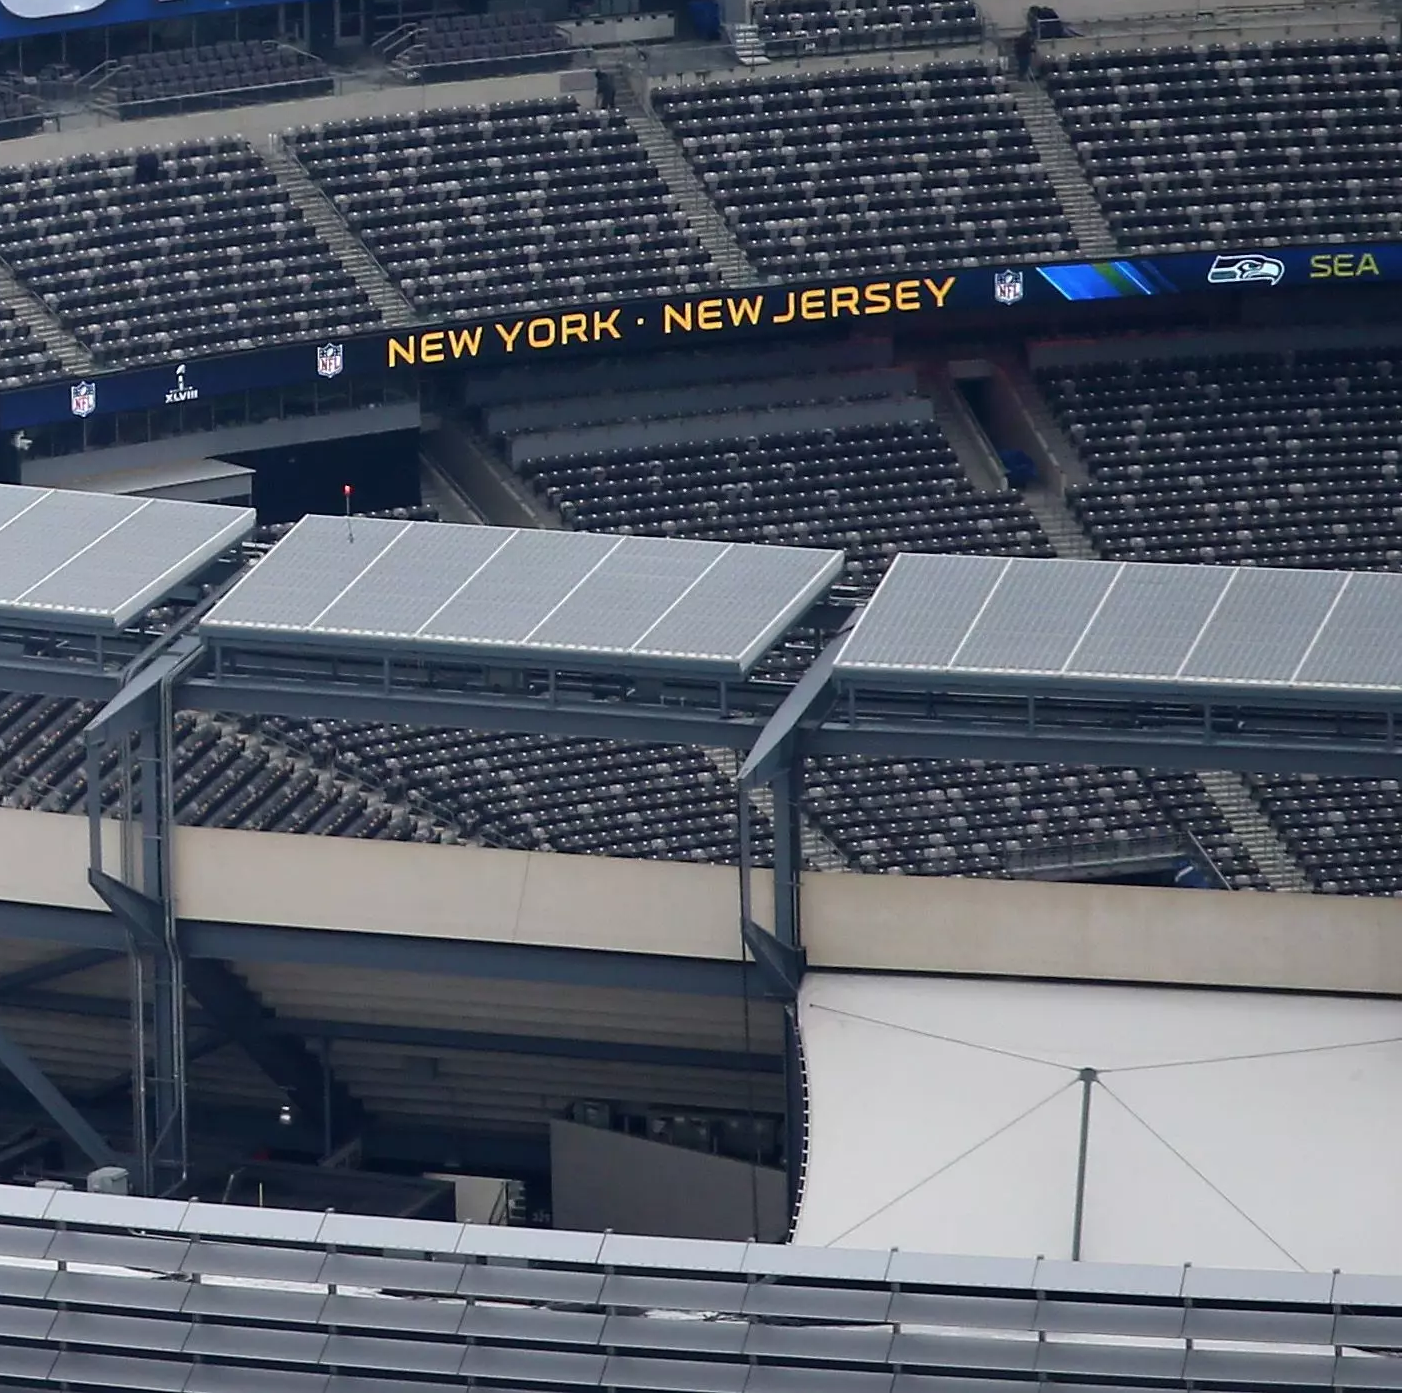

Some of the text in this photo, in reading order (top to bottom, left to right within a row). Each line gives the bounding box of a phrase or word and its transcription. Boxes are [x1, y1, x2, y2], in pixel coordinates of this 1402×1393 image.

[1310, 253, 1380, 278] SEA
[387, 329, 481, 368] NEW
[497, 309, 621, 353] YORK
[665, 295, 763, 334] NEW
[775, 277, 957, 324] JERSEY
[165, 388, 198, 403] XLVIII
